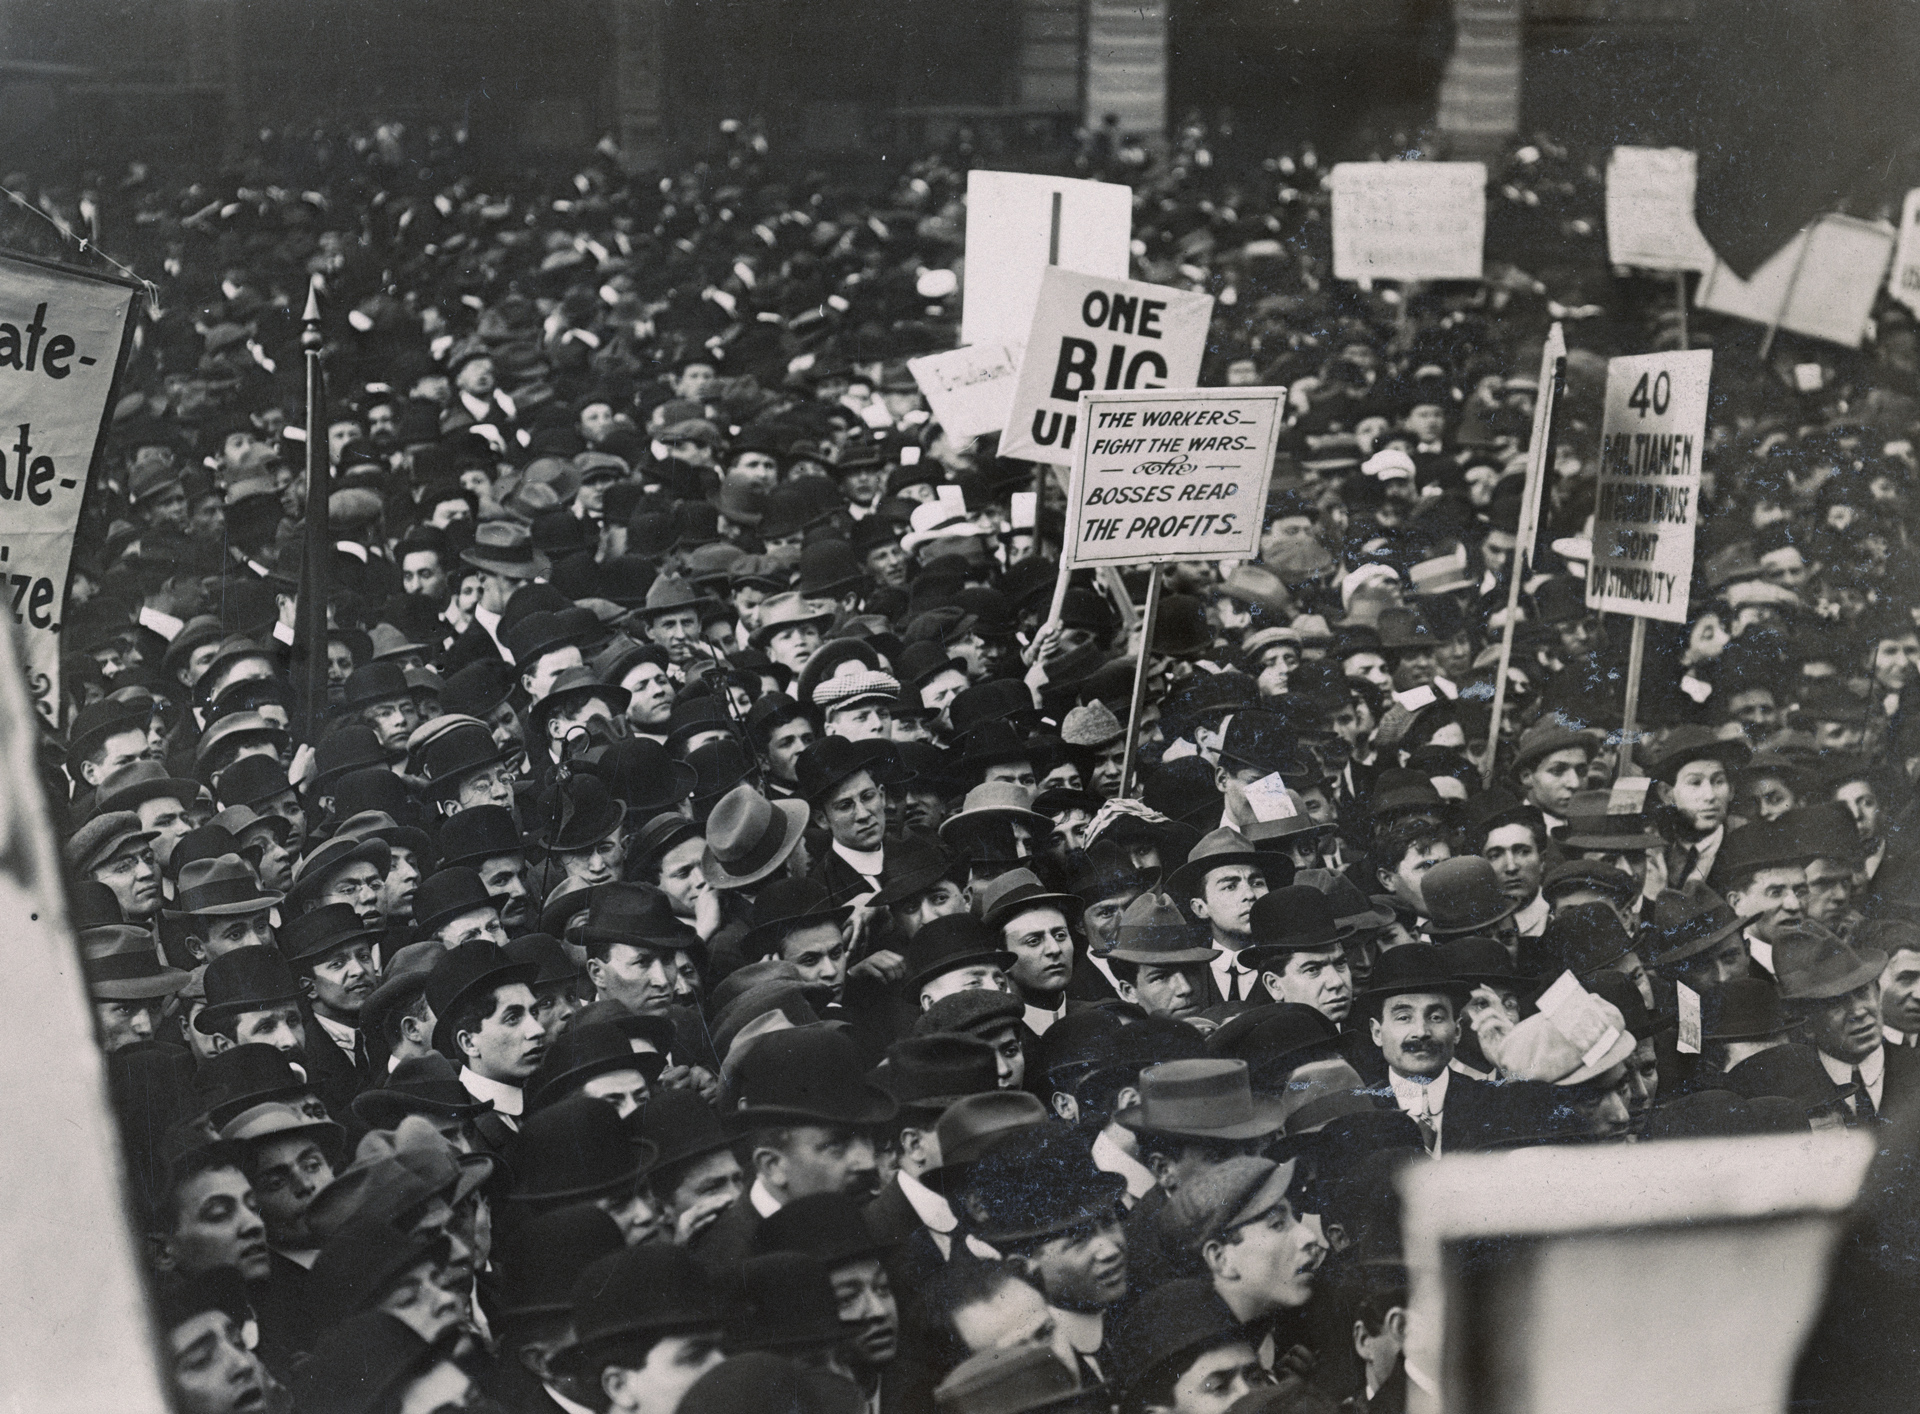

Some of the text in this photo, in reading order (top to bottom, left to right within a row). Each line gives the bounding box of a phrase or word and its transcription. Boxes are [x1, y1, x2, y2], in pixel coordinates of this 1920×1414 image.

[1082, 290, 1167, 339] ONE
[1050, 336, 1168, 402] BIG
[1628, 370, 1671, 418] 40
[1098, 412, 1137, 428] THE
[1092, 438, 1146, 455] FIGHT
[1148, 438, 1184, 453] THE
[1085, 483, 1239, 506] BOSSES REAP
[1083, 518, 1123, 542] THE
